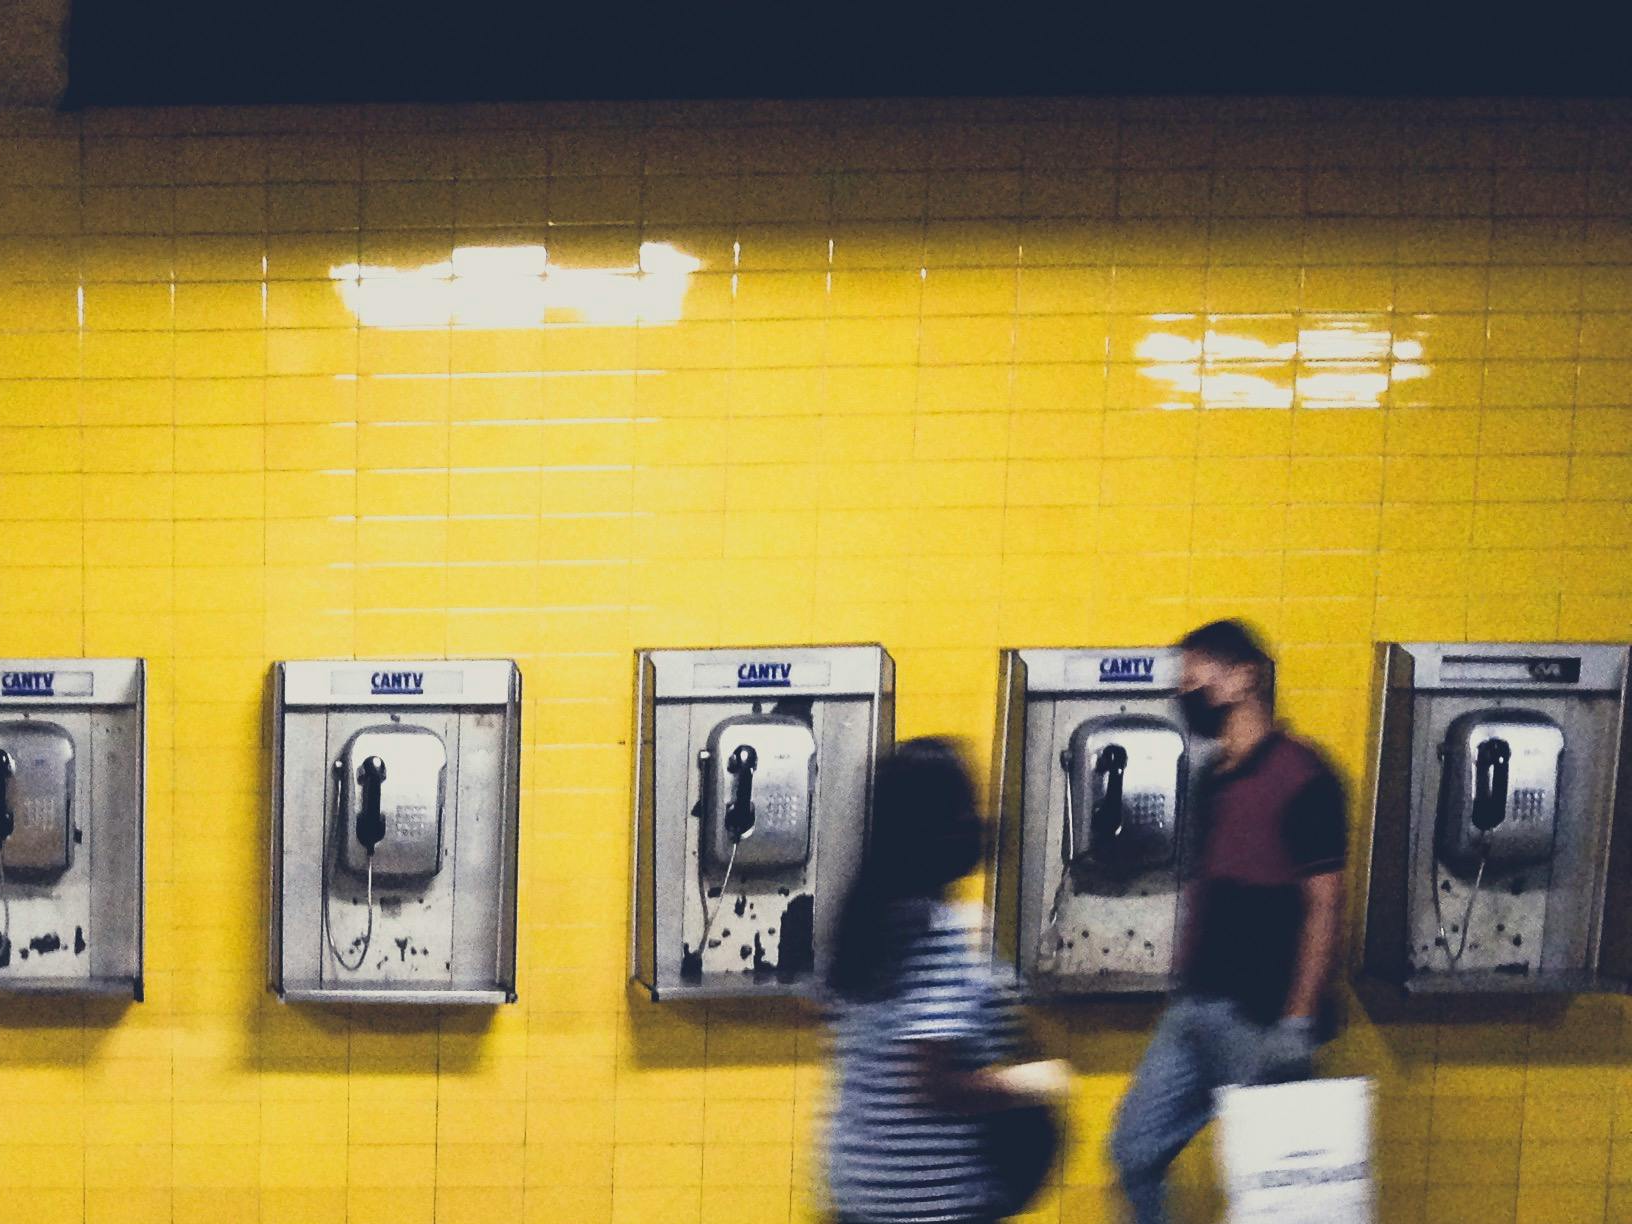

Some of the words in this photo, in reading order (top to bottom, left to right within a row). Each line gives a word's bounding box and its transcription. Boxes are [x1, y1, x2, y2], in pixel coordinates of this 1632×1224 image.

[738, 663, 791, 679] CANTV
[1100, 657, 1154, 673] CANTV
[2, 671, 54, 688] CANTV
[371, 672, 423, 688] CANTV
